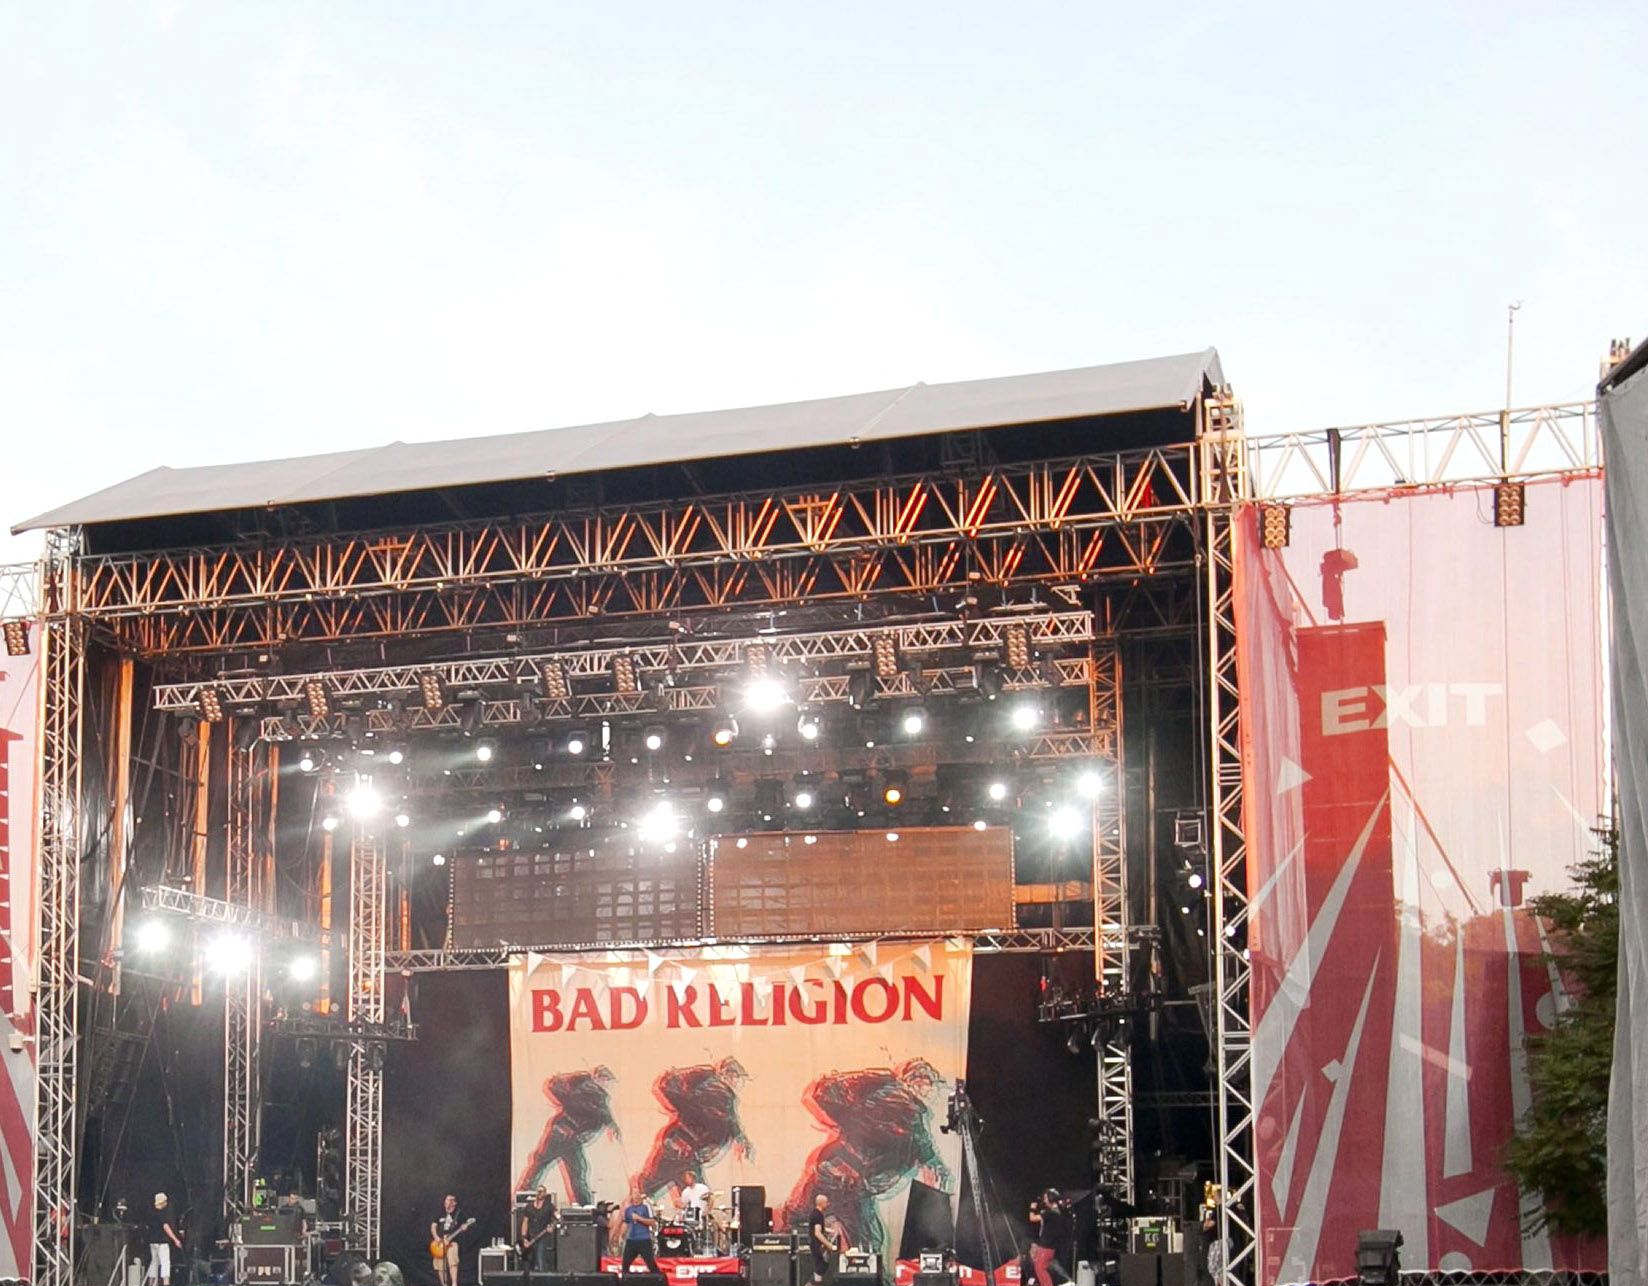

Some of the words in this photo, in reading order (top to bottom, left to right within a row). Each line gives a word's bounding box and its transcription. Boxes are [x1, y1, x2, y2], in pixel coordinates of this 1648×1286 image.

[1321, 682, 1503, 737] EXIT
[531, 985, 649, 1032] BAD
[666, 974, 945, 1029] RELIGION
